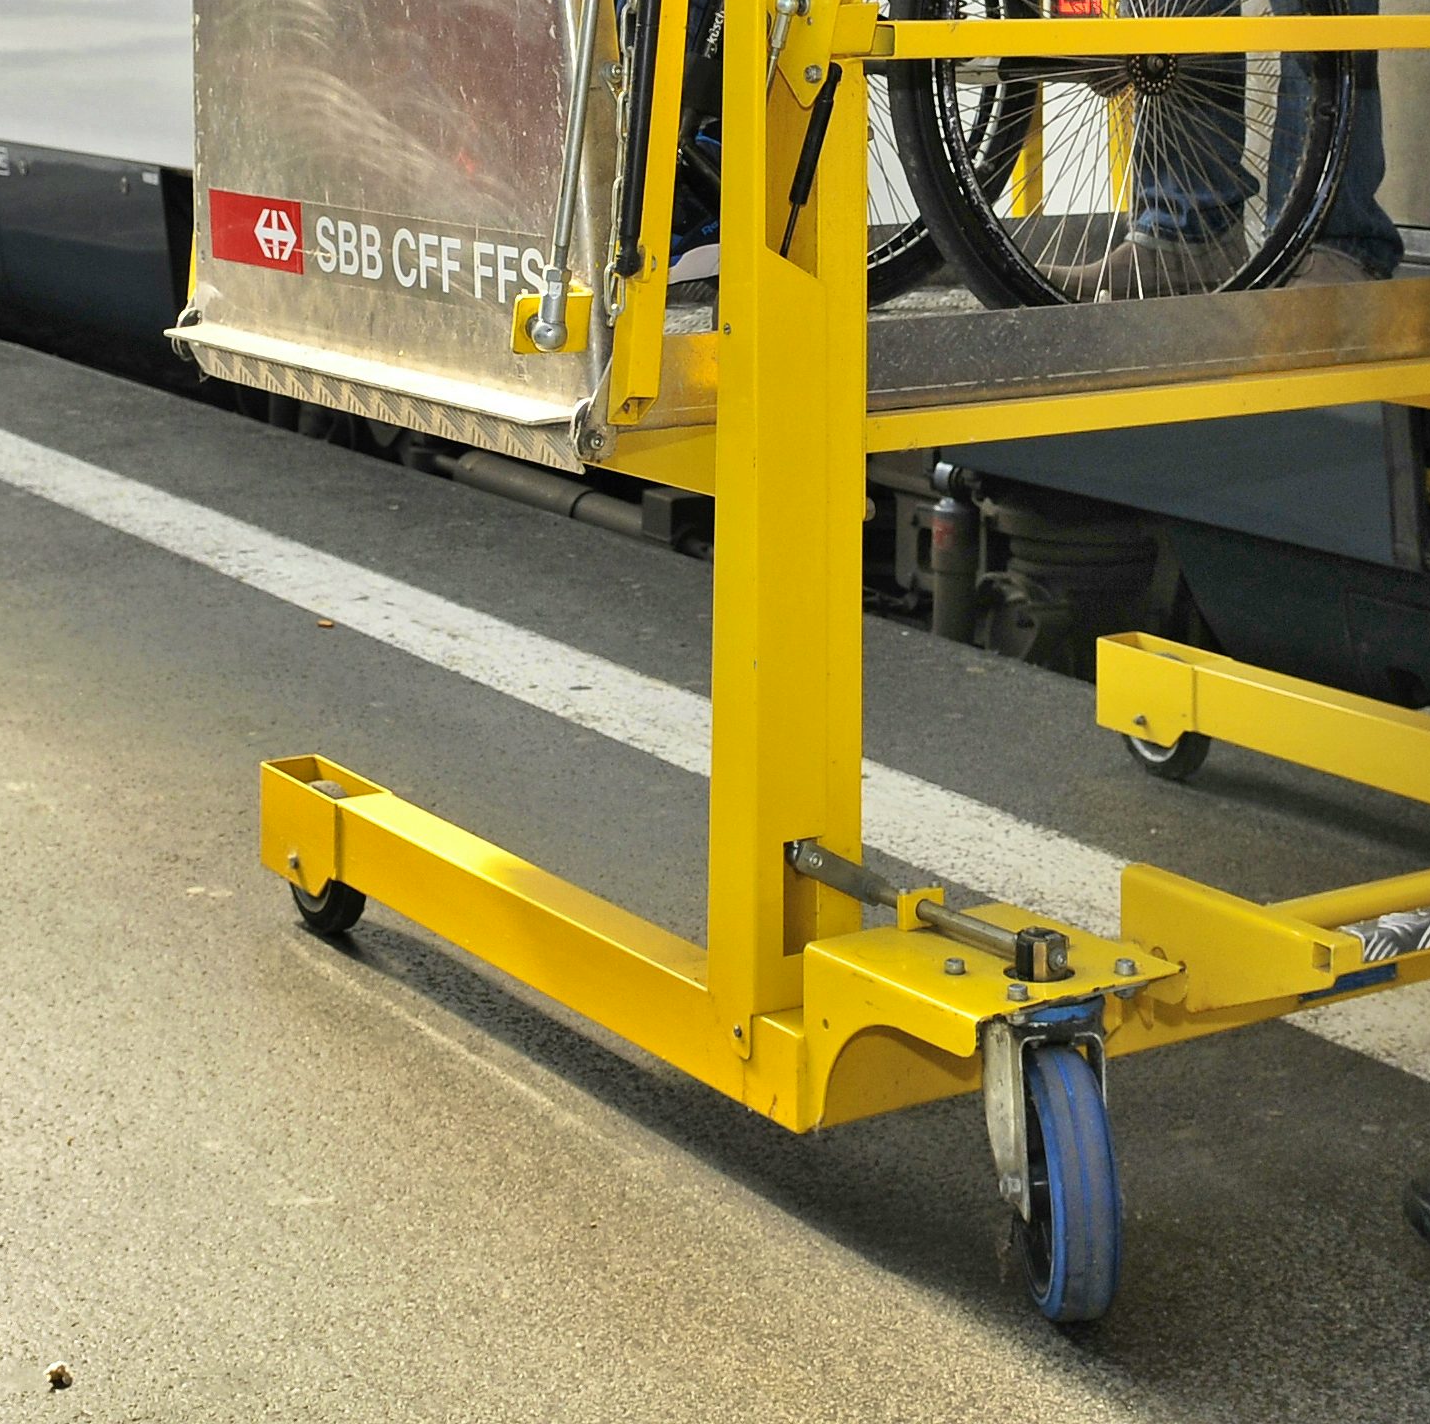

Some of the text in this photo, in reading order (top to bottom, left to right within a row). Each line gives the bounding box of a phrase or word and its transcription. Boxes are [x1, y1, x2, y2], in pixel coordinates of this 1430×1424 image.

[315, 215, 547, 304] SBB CFF FFS
